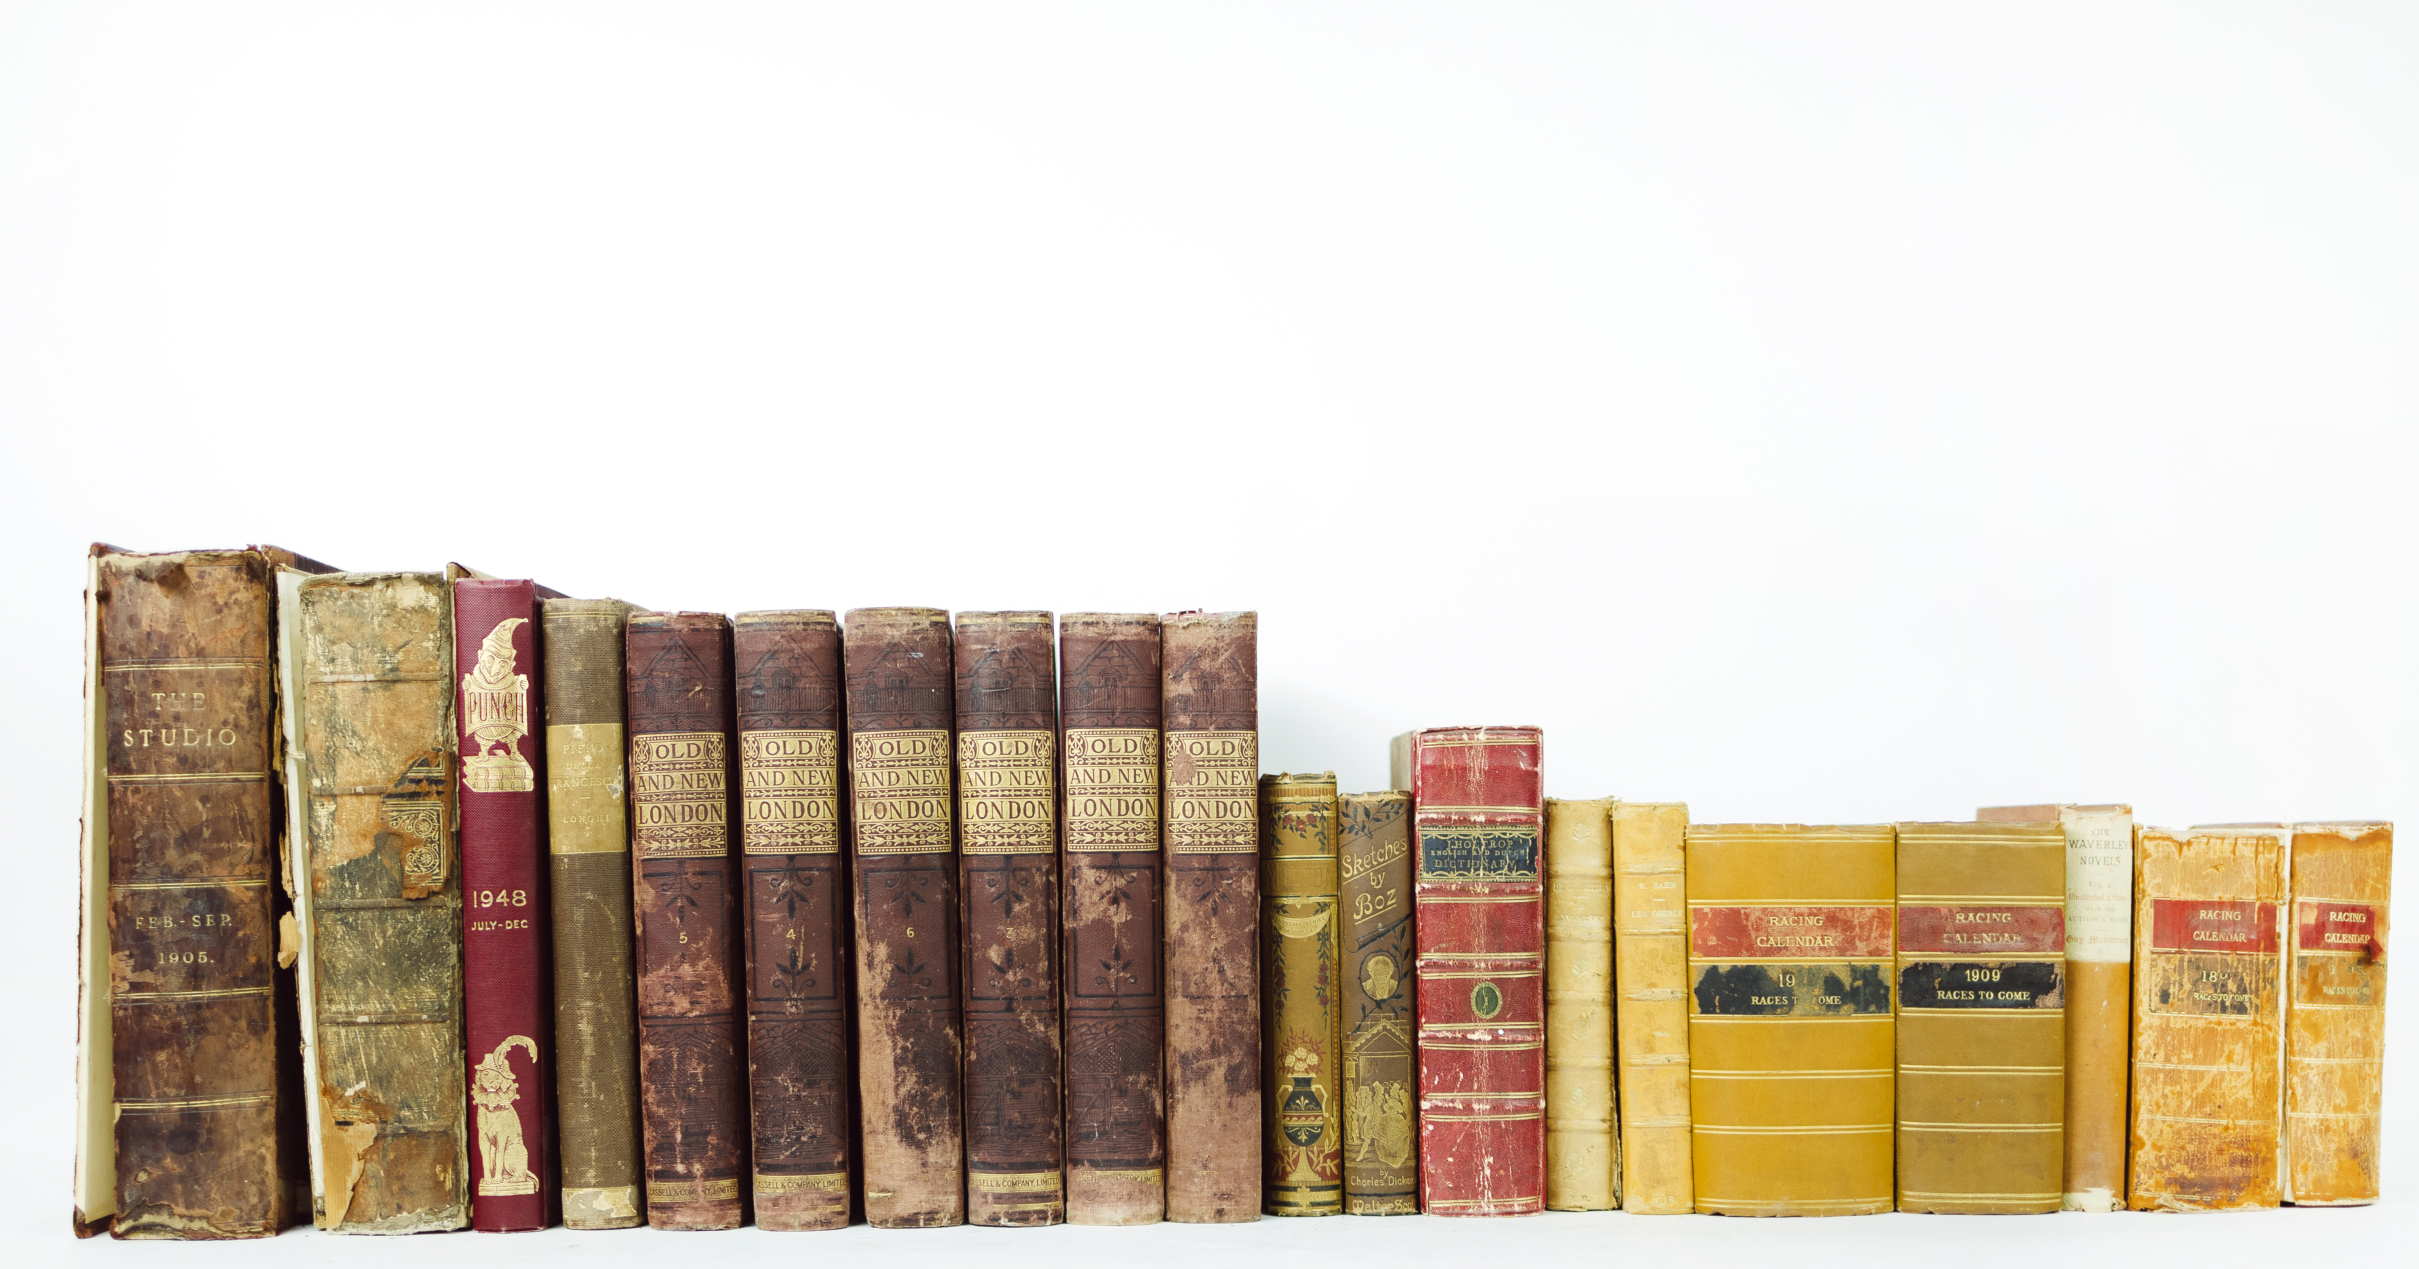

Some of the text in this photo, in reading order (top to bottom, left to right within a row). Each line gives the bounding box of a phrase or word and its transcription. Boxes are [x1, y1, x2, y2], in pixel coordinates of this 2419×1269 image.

[151, 692, 207, 711] THE
[468, 691, 524, 724] PUNCH
[123, 728, 236, 747] STUDIO
[655, 742, 701, 760] OLD
[765, 739, 813, 756] OLD
[879, 739, 927, 756] OLD
[982, 740, 1029, 756] OLD
[1091, 738, 1138, 754] OLD
[1189, 740, 1236, 756] OLD
[551, 777, 616, 788] FRANCESC
[637, 772, 723, 792] AND NEW
[746, 769, 834, 787] AND NEW
[858, 769, 948, 788] AND NEW
[964, 770, 1050, 787] AND NEW
[1070, 768, 1157, 785] AND NEW
[1215, 770, 1256, 786] NEW
[638, 803, 724, 825] LONDON
[747, 799, 835, 820] LONDON
[861, 799, 948, 820] LONDON
[965, 800, 1050, 820] LONDON
[1071, 798, 1157, 818] LONDON
[1168, 800, 1256, 819] LONDON
[562, 814, 610, 824] LONGHI
[2091, 828, 2110, 836] THE
[2068, 839, 2130, 850] WAVERLEY
[1342, 837, 1408, 878] Sketches
[2079, 856, 2121, 867] NOVELS
[1369, 871, 1386, 889] by
[1652, 881, 1676, 889] BAZIN
[473, 889, 527, 908] 1948
[1631, 910, 1648, 918] LES
[1955, 912, 2012, 923] RACING
[2199, 909, 2242, 921] RACING
[2329, 911, 2367, 923] RACING
[471, 919, 528, 931] JULY-DEC
[1768, 916, 1824, 926] RACING
[679, 931, 688, 944] 5
[786, 928, 796, 940] 4
[906, 926, 915, 938] 6
[1943, 932, 2024, 944] CALENDAR
[2193, 930, 2248, 943] CALENDAR
[1756, 936, 1836, 947] CALENDAR
[158, 951, 215, 964] 1905.
[1965, 968, 2001, 982] 1909
[1937, 990, 2031, 1001] RACES TO COME
[2322, 986, 2346, 995] RACES
[1751, 995, 1789, 1005] RACES
[1818, 995, 1842, 1005] OME
[1379, 1168, 1389, 1179] by
[780, 1182, 787, 1190] &
[995, 1180, 1001, 1188] &
[1350, 1175, 1415, 1187] Charles Dicken
[680, 1187, 712, 1197] COMPNY,
